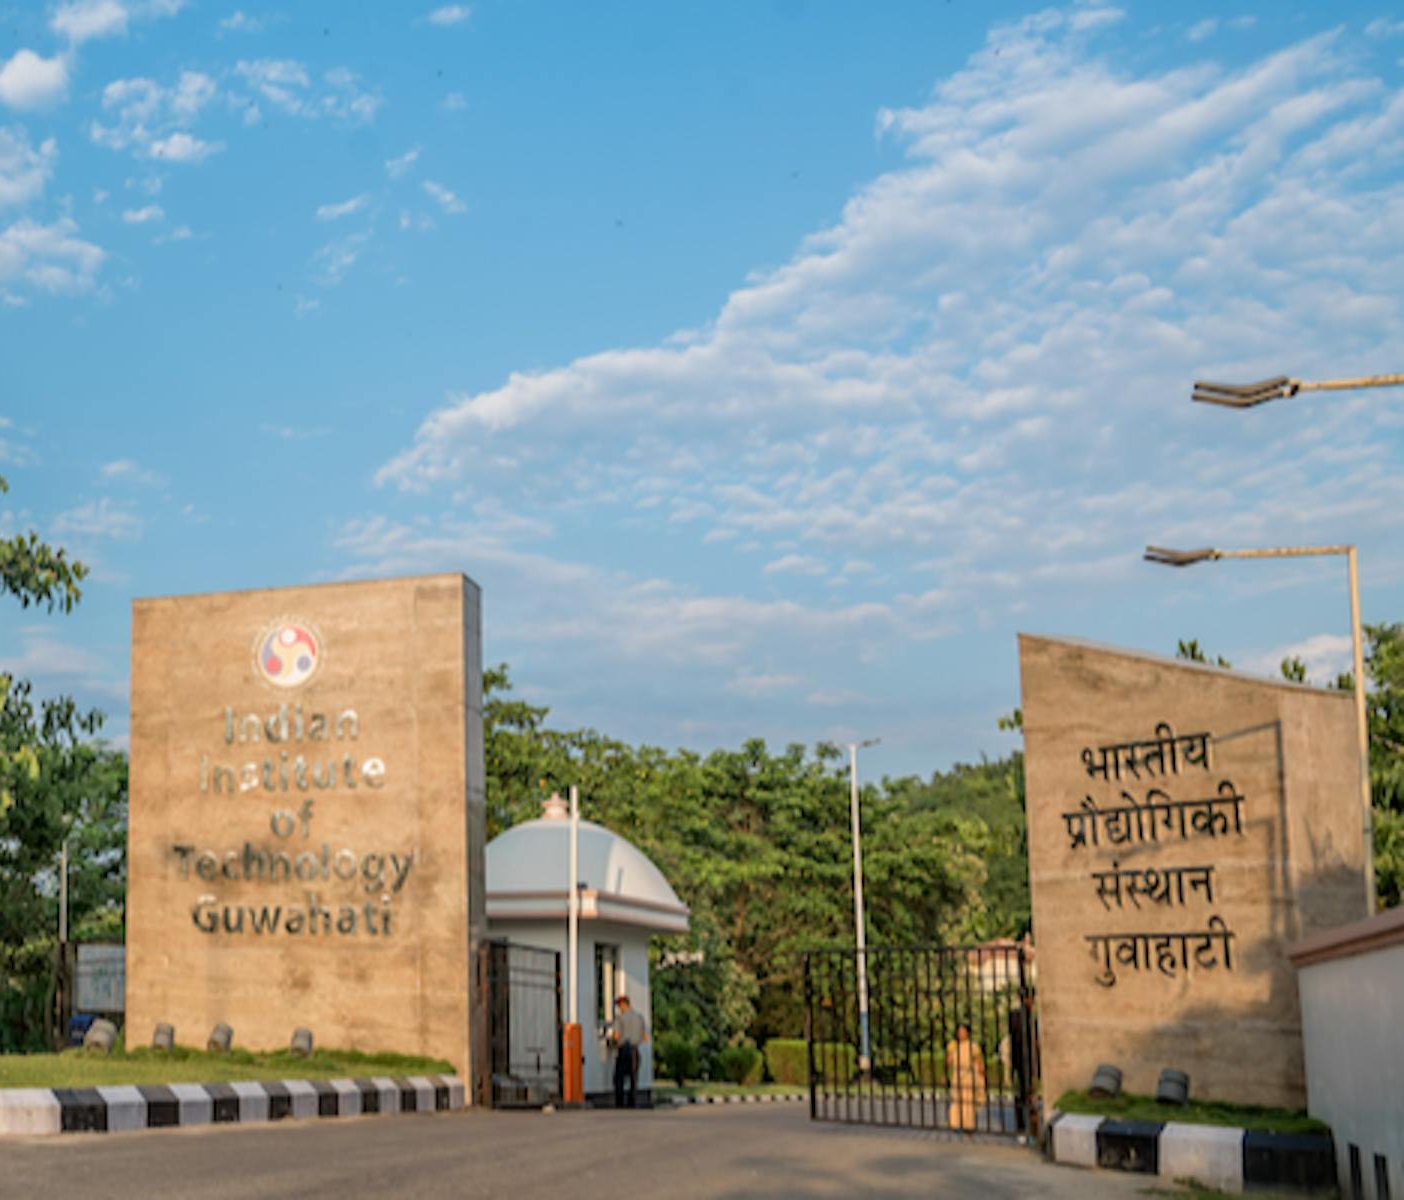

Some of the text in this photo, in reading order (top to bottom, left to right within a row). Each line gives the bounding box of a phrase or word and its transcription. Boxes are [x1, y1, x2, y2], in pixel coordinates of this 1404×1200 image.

[223, 703, 359, 745] Indian
[199, 751, 386, 794] Institute
[1081, 722, 1211, 780] भारतीय
[270, 799, 315, 838] of
[1061, 779, 1245, 849] प्रौद्योगिकी
[173, 842, 414, 893] Technology
[1091, 860, 1215, 911] संस्थान
[192, 889, 392, 936] Guwahati
[1084, 914, 1236, 988] गुवाहाटी
